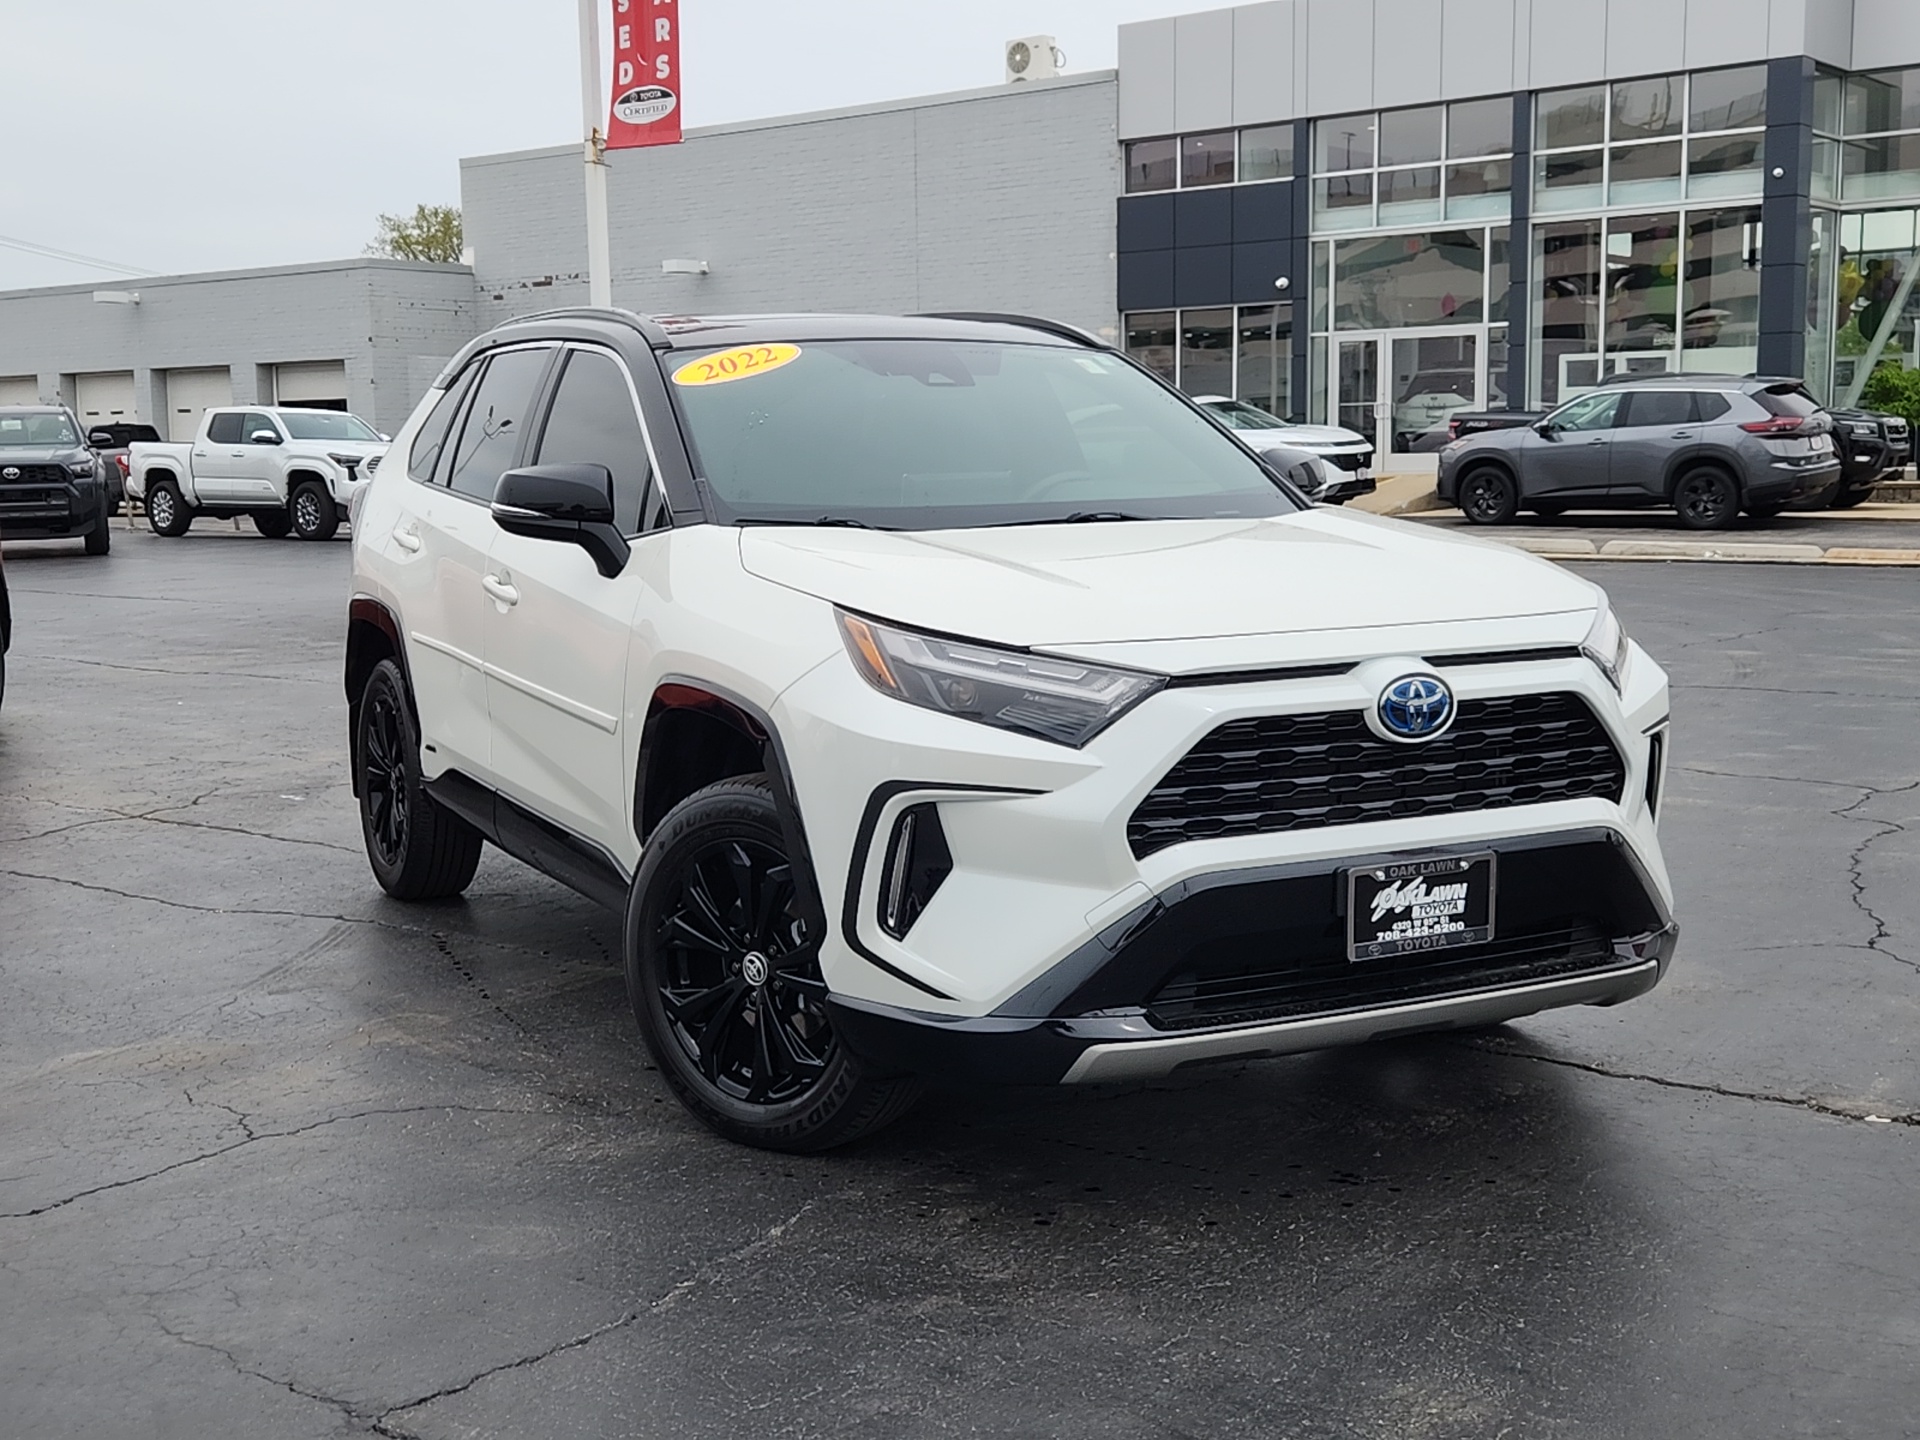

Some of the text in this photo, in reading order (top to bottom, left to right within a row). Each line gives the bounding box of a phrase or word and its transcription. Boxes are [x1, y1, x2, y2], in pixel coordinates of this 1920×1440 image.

[653, 0, 670, 79] RS
[640, 91, 662, 100] TOYOTA
[623, 103, 668, 117] CERTIFIED
[697, 347, 778, 382] 2022
[1390, 860, 1456, 877] OAK LAWN
[1418, 904, 1459, 916] TOYOTA
[1376, 921, 1465, 942] 708-423-5200
[1395, 934, 1448, 952] TOYOTA
